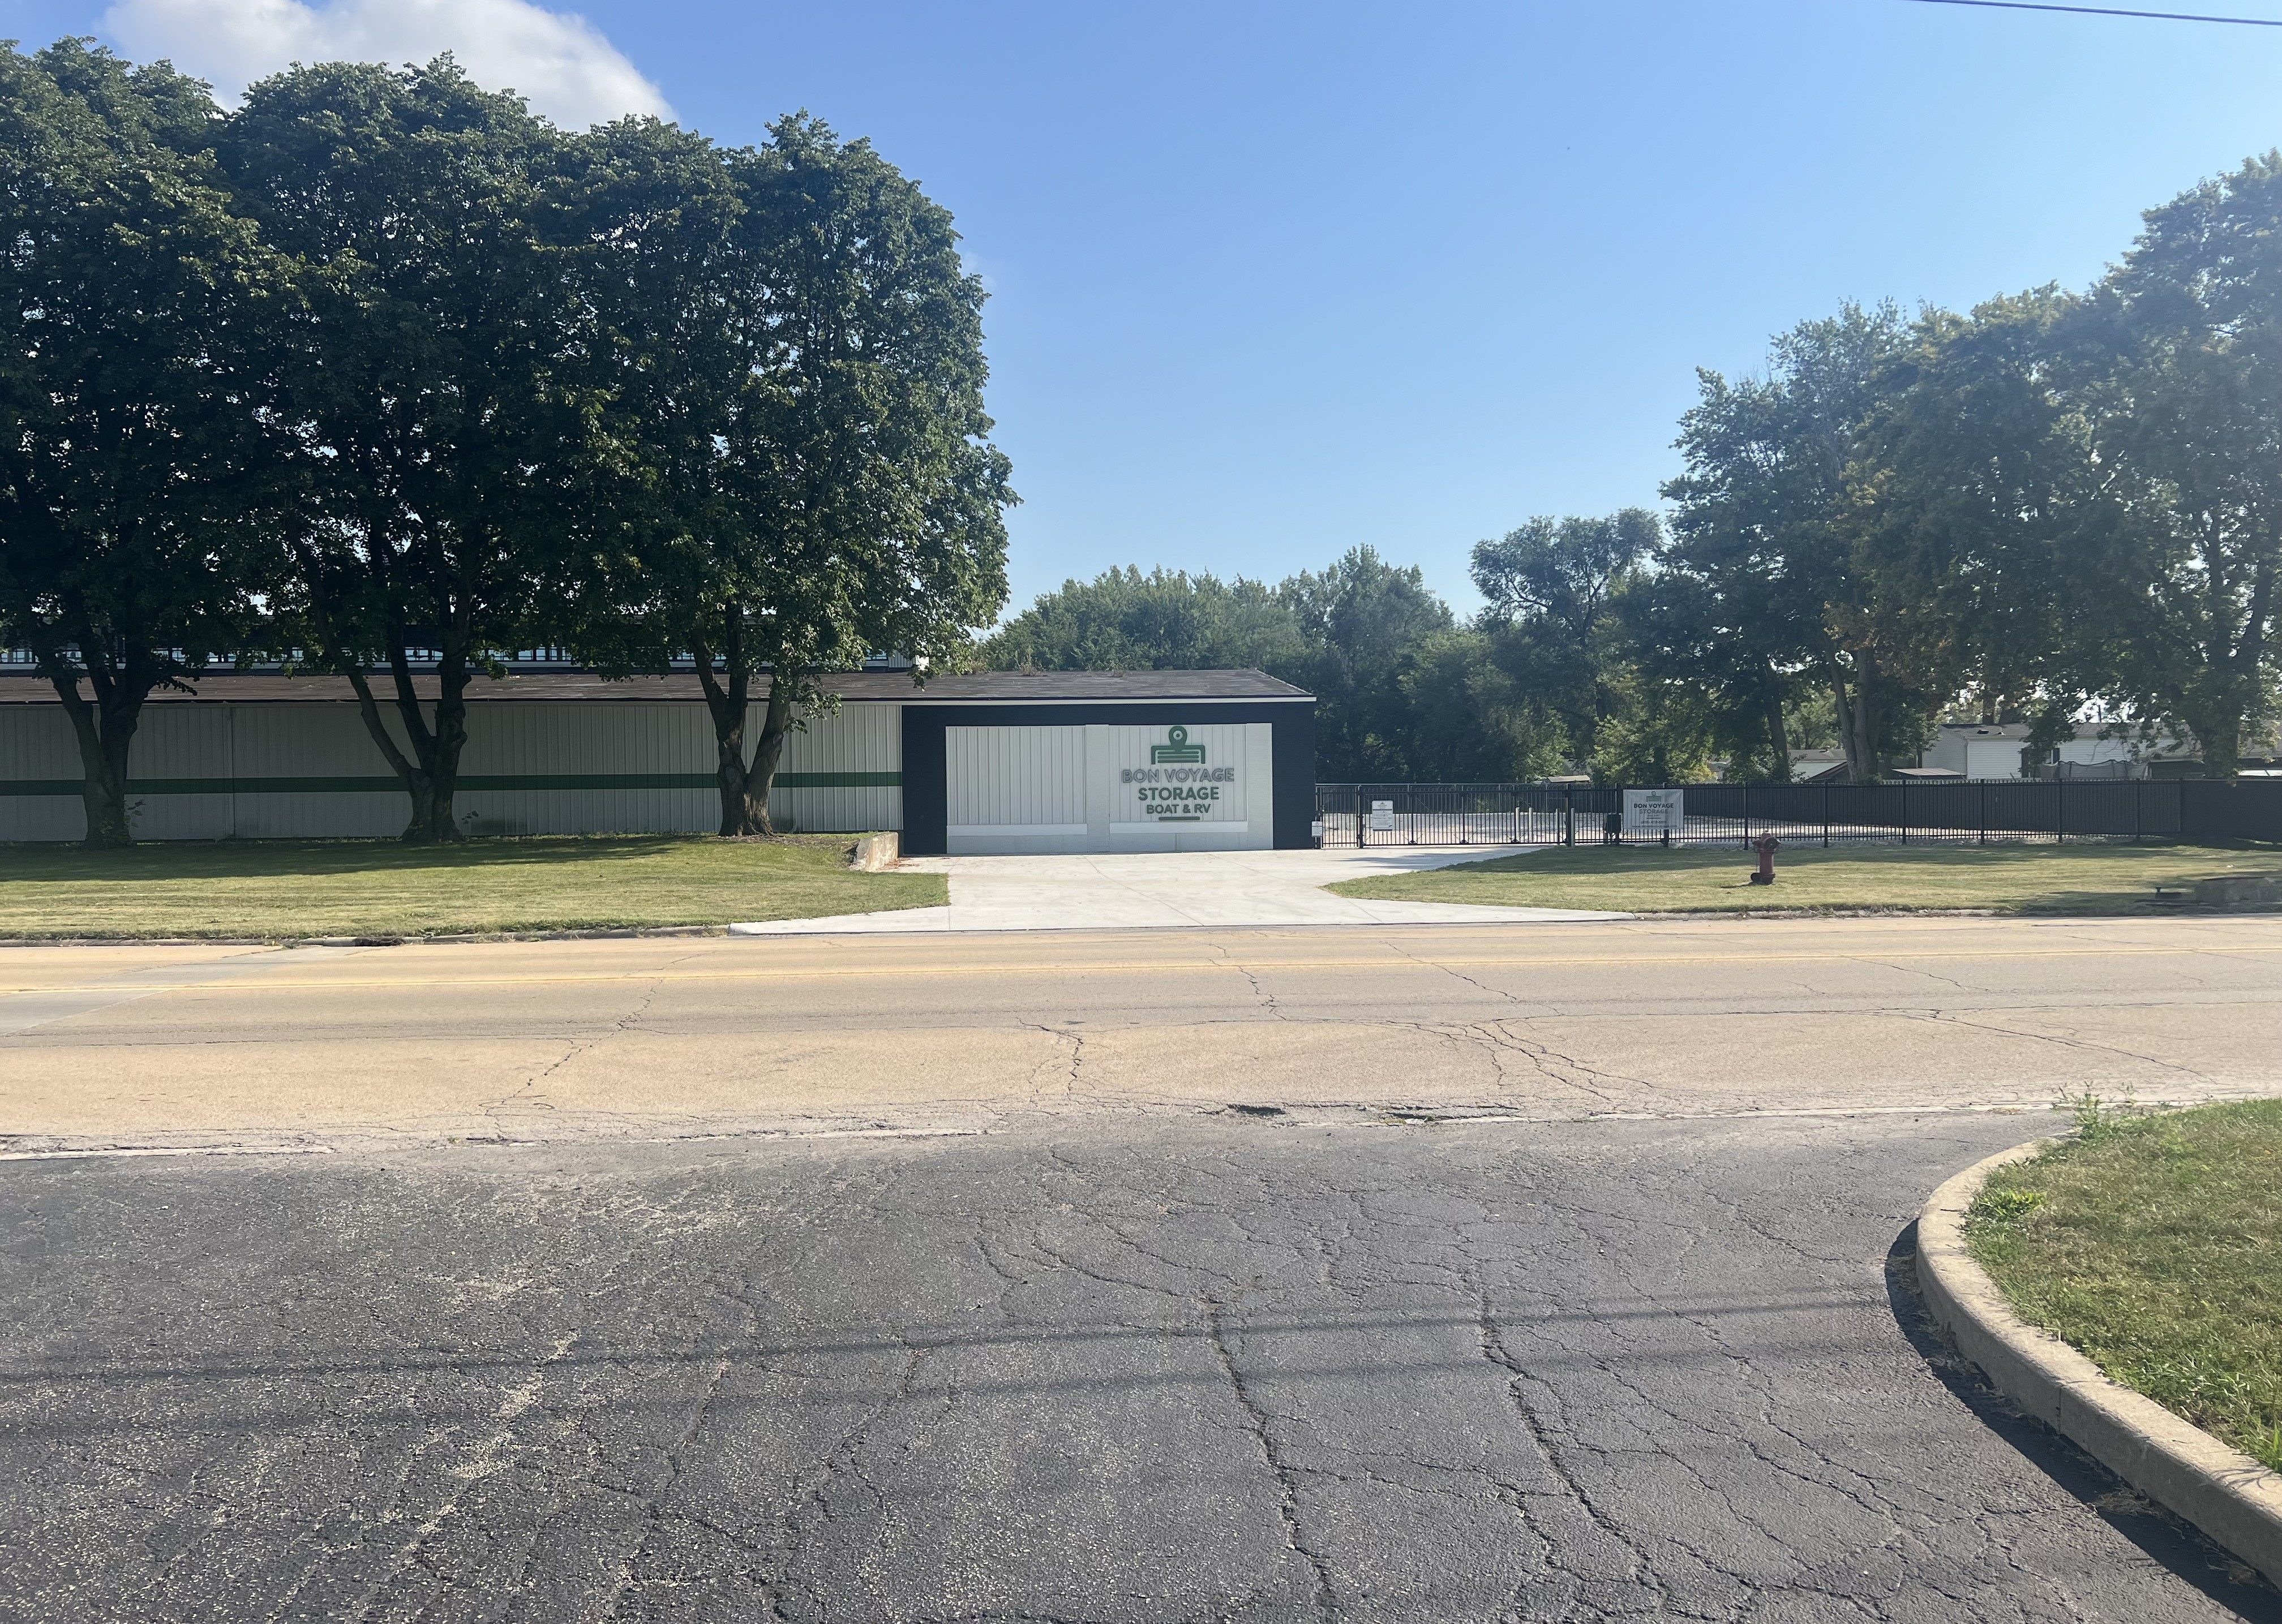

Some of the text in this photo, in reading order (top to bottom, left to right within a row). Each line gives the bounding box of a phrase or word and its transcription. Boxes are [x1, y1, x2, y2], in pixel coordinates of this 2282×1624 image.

[1122, 768, 1234, 783] BON VOYAGE
[1138, 787, 1219, 801] STORAGE
[1147, 804, 1211, 814] BOAT & RV
